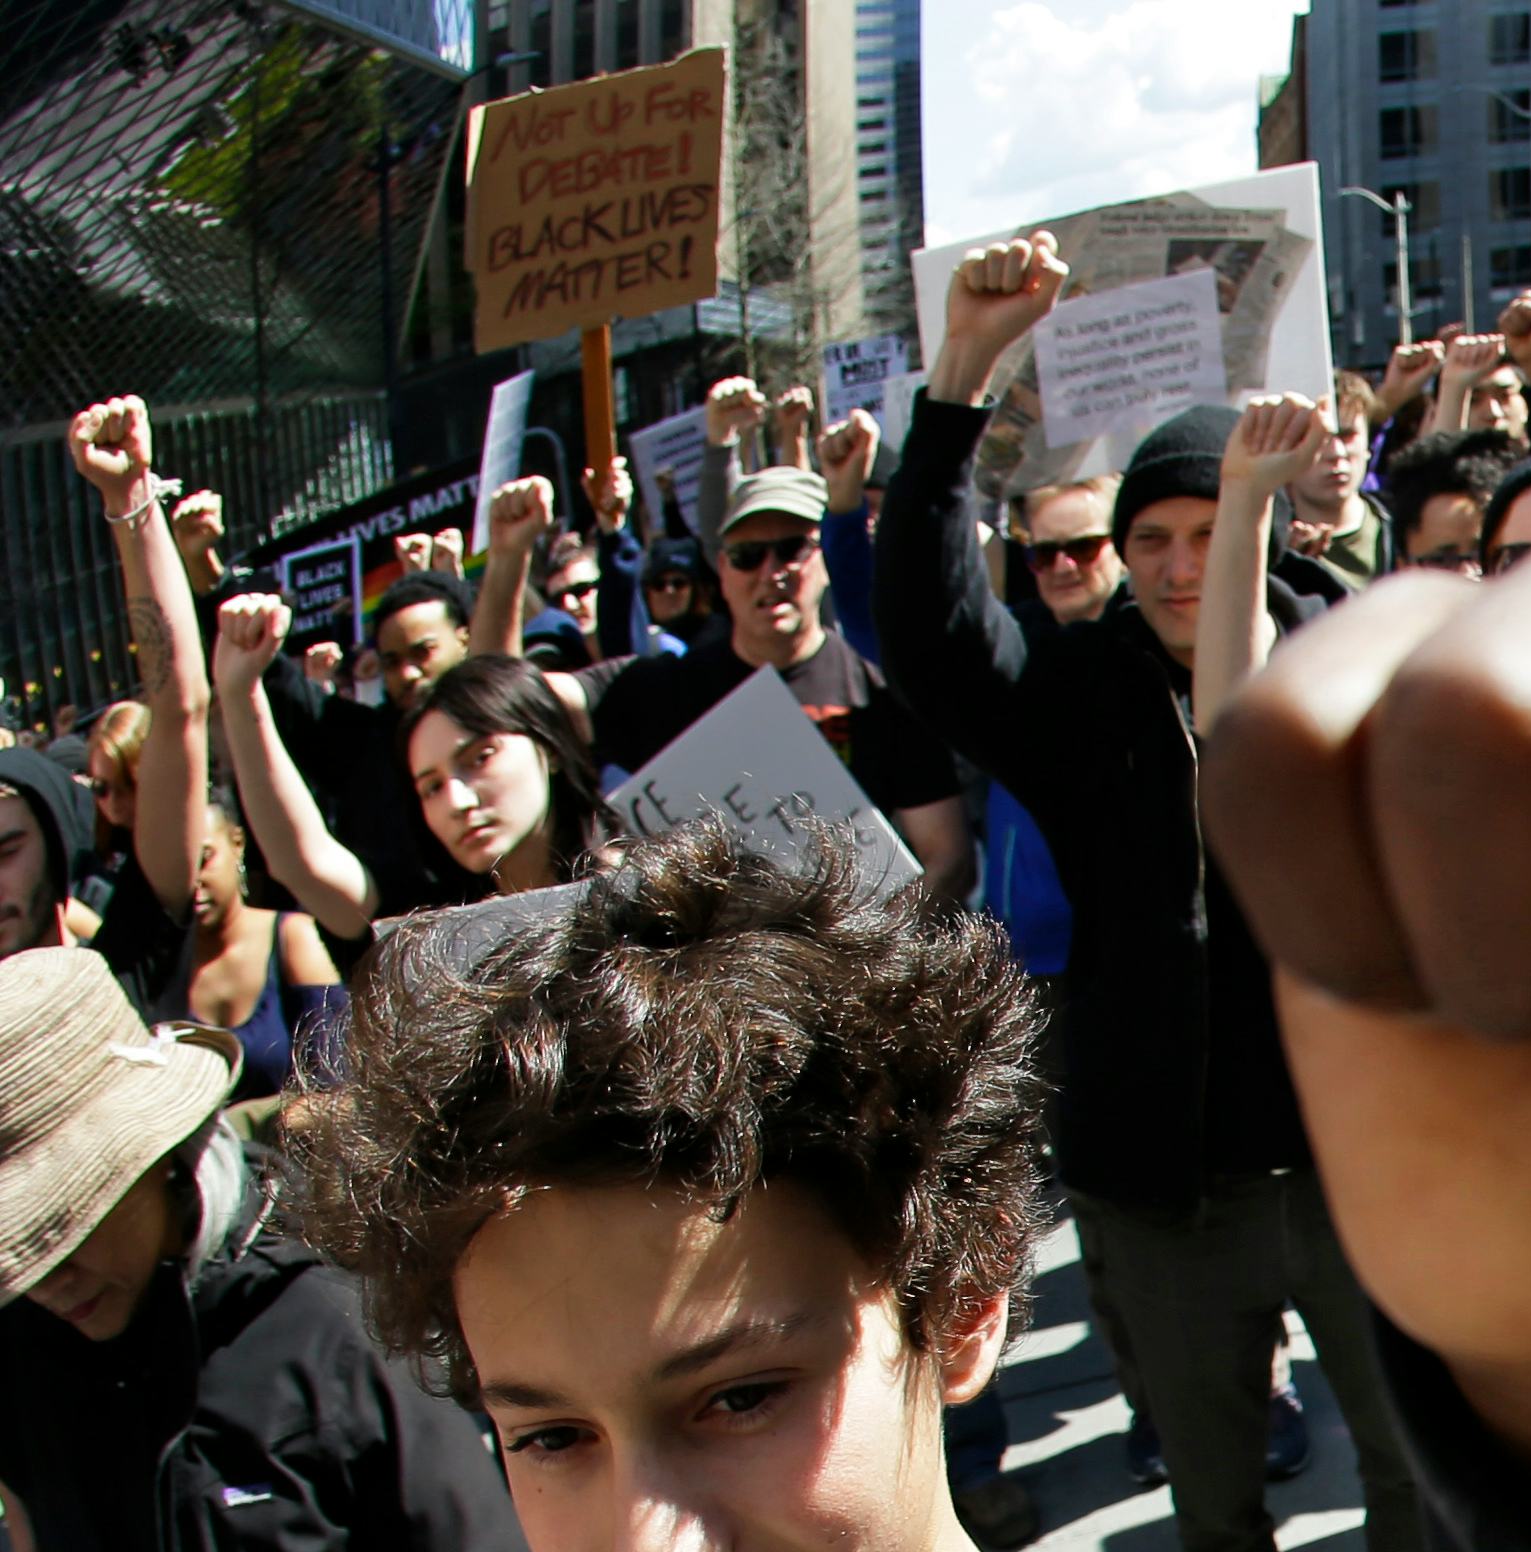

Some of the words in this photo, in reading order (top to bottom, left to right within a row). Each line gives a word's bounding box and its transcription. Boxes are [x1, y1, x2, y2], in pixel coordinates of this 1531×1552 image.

[586, 91, 634, 134] UP
[519, 131, 694, 205] DEBATE!
[487, 201, 616, 272] BLACK
[620, 184, 716, 239] LIVES
[504, 235, 694, 318] MATTER!
[408, 474, 481, 523] MATT
